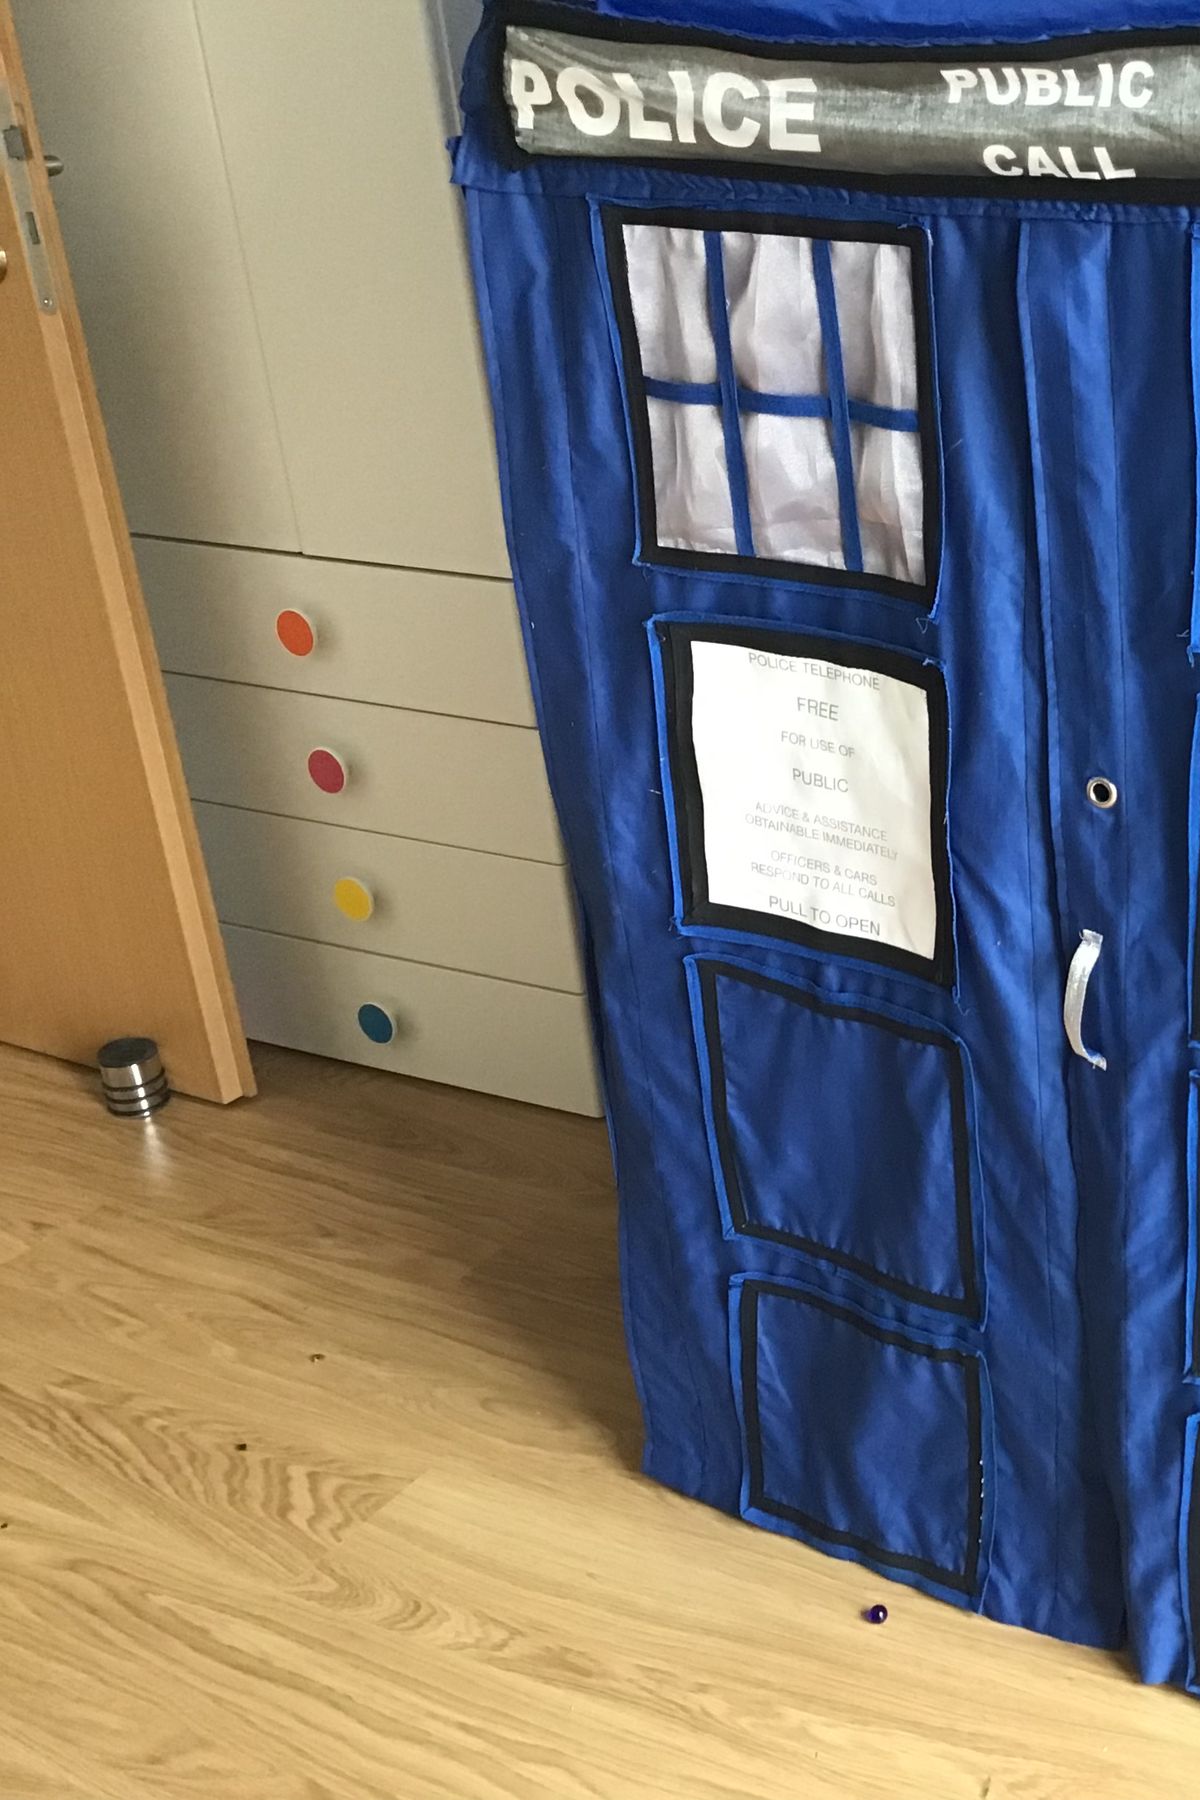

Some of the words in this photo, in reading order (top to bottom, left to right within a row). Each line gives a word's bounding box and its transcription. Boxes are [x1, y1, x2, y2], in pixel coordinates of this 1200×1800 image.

[940, 61, 1154, 108] PUBLIC
[510, 59, 822, 153] POLICE
[982, 145, 1136, 179] CALL
[748, 653, 797, 672] POLICE
[803, 662, 880, 690] TELEPHONE
[797, 697, 839, 721] FREE
[781, 731, 806, 746] FOR
[810, 737, 835, 753] USE
[838, 744, 856, 758] OF
[792, 767, 849, 793] PUBLIC
[745, 813, 820, 840] OBTAINABLE
[823, 831, 899, 860] IMMEDIATELY
[755, 801, 800, 820] ADVICE
[802, 812, 811, 823] &
[813, 814, 888, 842] ASSISTANCE
[751, 862, 809, 885] RESPOND
[813, 876, 830, 890] TO
[833, 881, 854, 896] ALL
[858, 886, 896, 907] CALLS
[771, 850, 831, 874] OFFICERS
[833, 865, 842, 876] &
[844, 867, 878, 886] CARS
[768, 895, 808, 917] PULL
[809, 907, 831, 924] TO
[835, 913, 881, 936] OPEN
